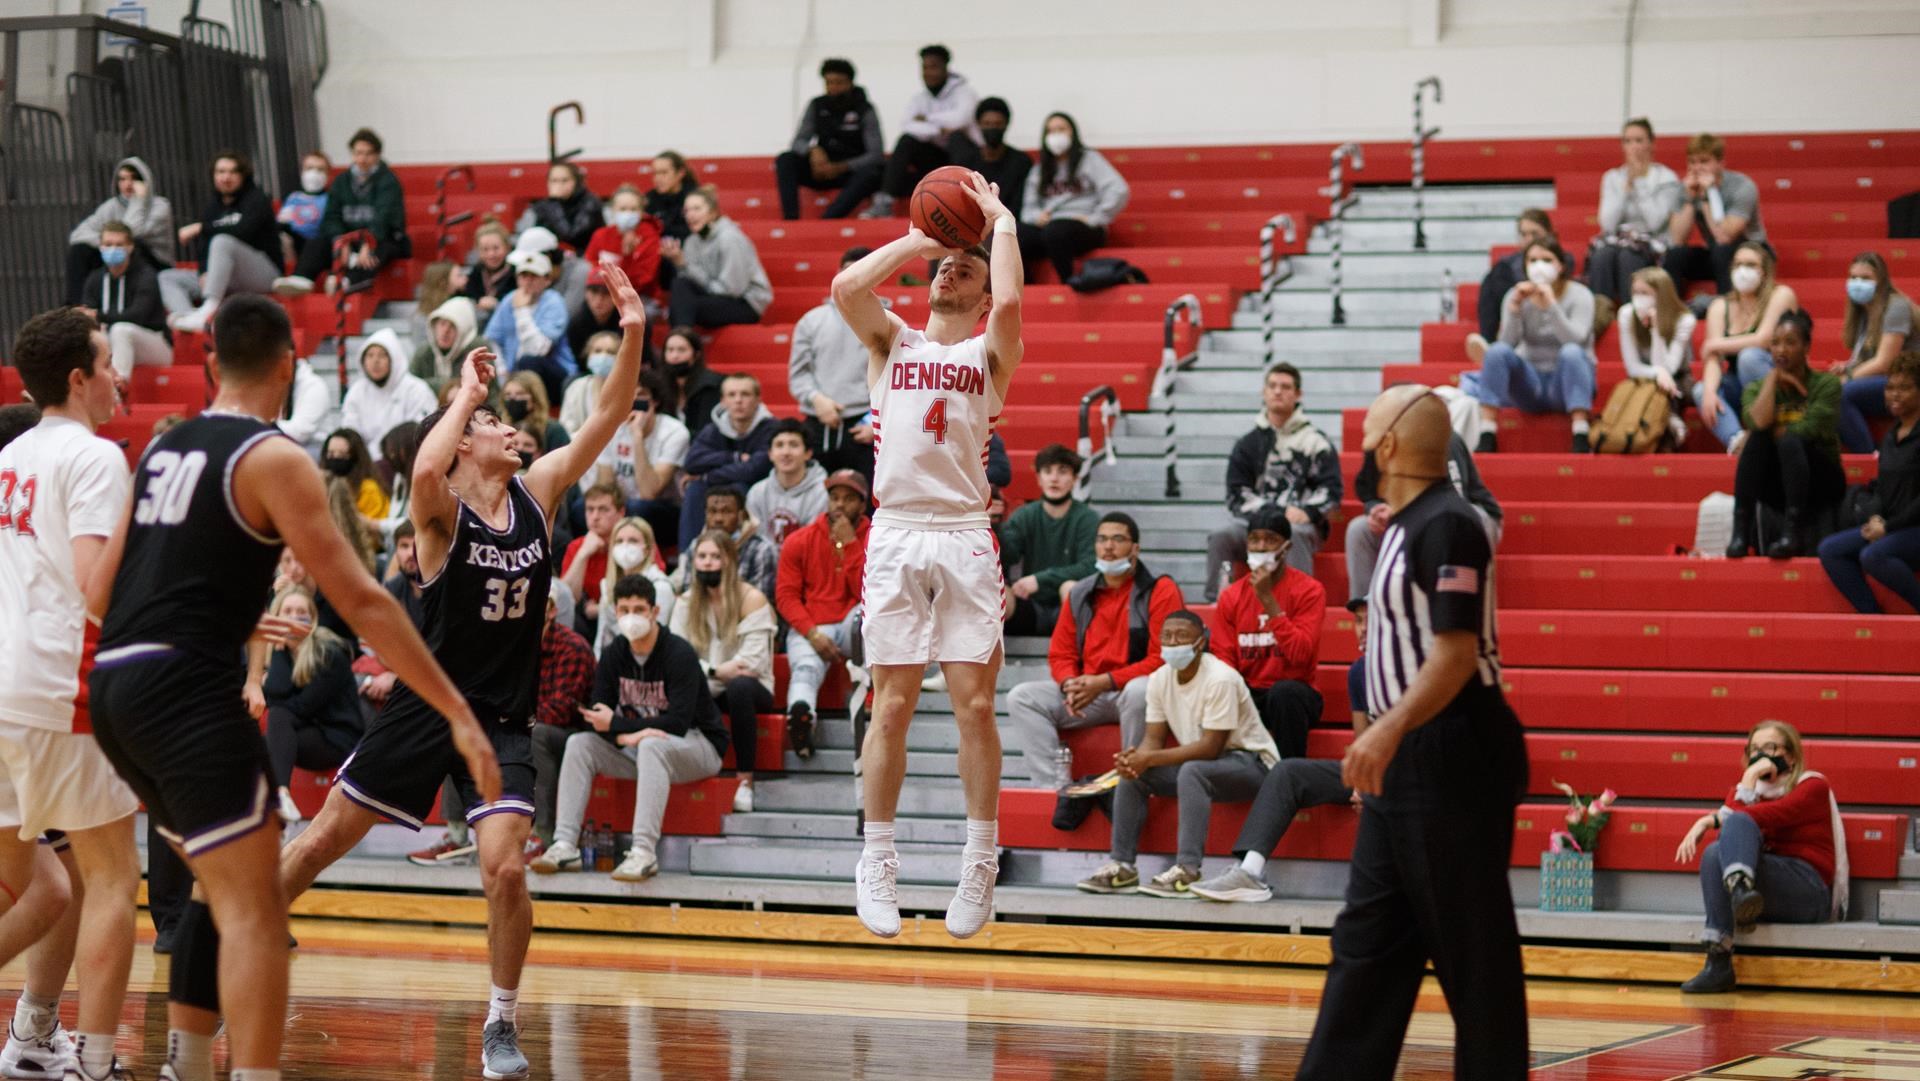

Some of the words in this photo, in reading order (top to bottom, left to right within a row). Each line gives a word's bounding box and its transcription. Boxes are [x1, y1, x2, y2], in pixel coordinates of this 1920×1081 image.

[890, 362, 985, 396] DENISON
[922, 398, 948, 445] 4
[134, 450, 208, 525] 30
[466, 538, 543, 571] KENYON
[481, 576, 530, 621] 33
